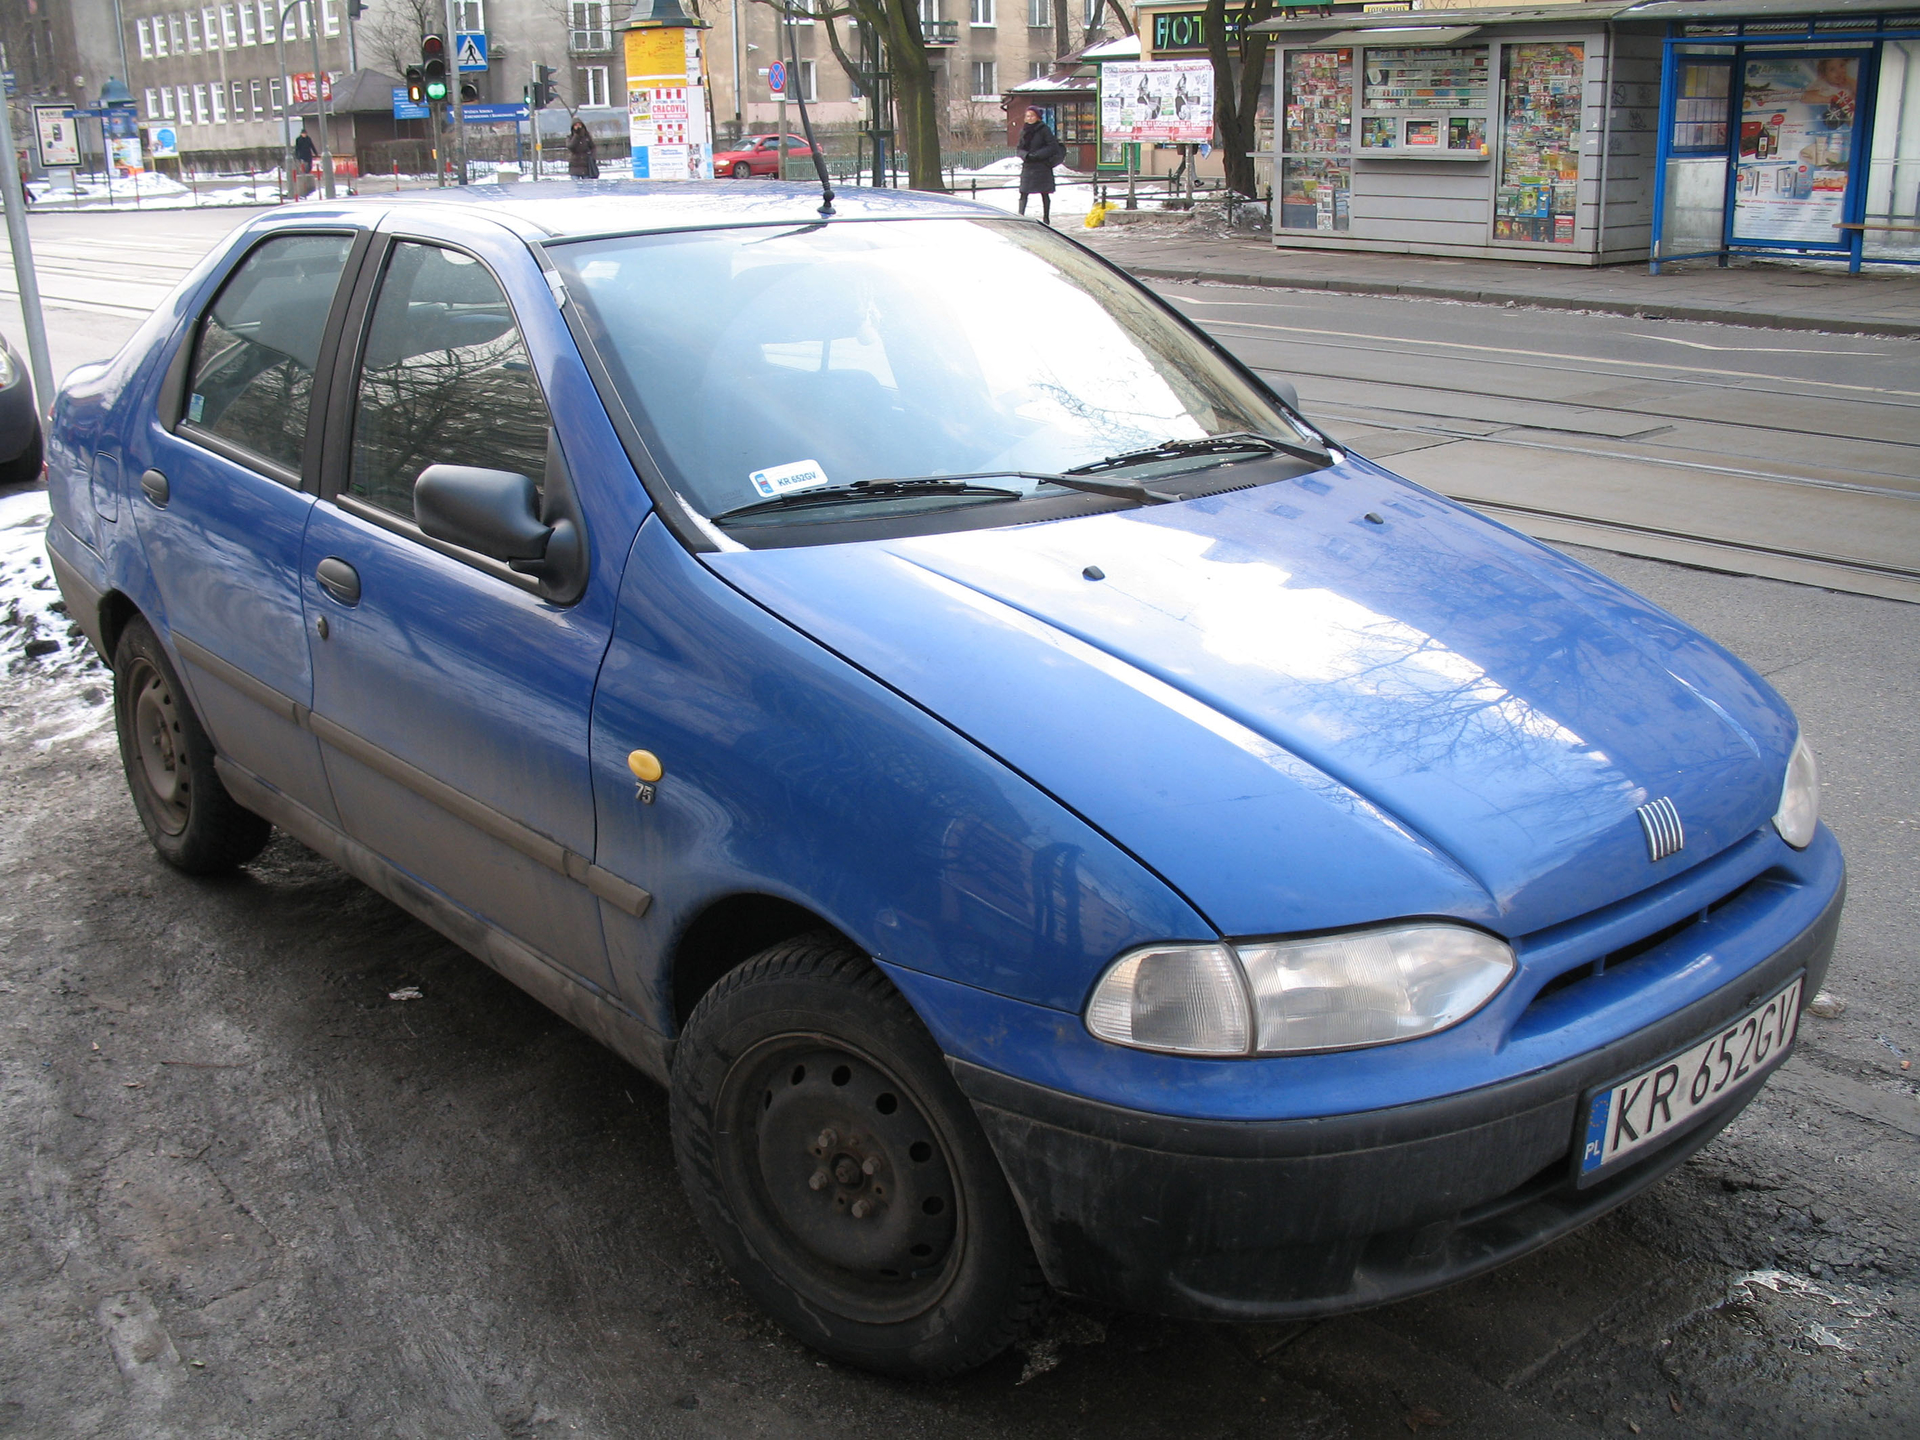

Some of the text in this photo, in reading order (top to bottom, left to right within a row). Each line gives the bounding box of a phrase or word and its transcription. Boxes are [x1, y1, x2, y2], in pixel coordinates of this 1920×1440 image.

[652, 104, 686, 113] CRACOVIA
[777, 471, 817, 486] KR 652GV
[1612, 985, 1797, 1151] KR 652GV
[1584, 1140, 1600, 1160] PL
